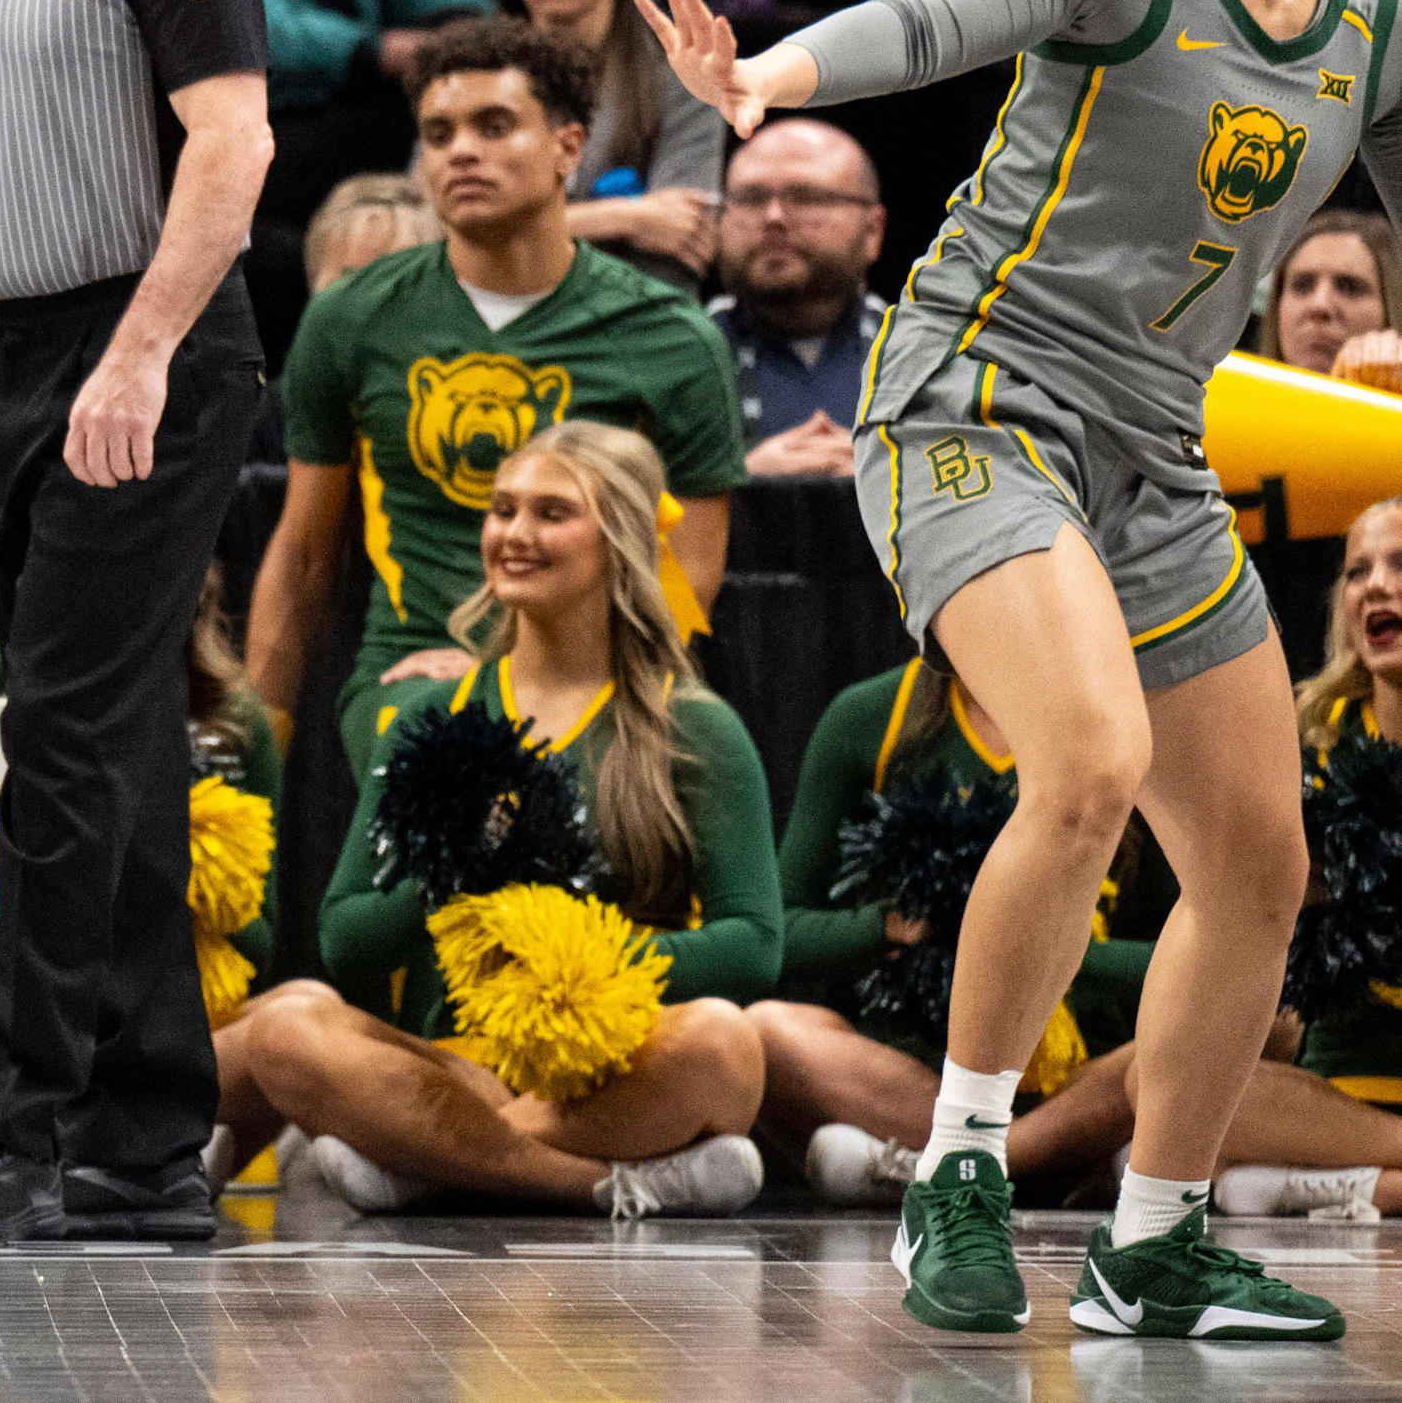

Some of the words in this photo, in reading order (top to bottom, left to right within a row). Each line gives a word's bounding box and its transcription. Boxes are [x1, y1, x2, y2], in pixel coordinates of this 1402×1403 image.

[1316, 68, 1356, 106] XII
[1148, 239, 1240, 333] 7
[925, 436, 994, 503] BU
